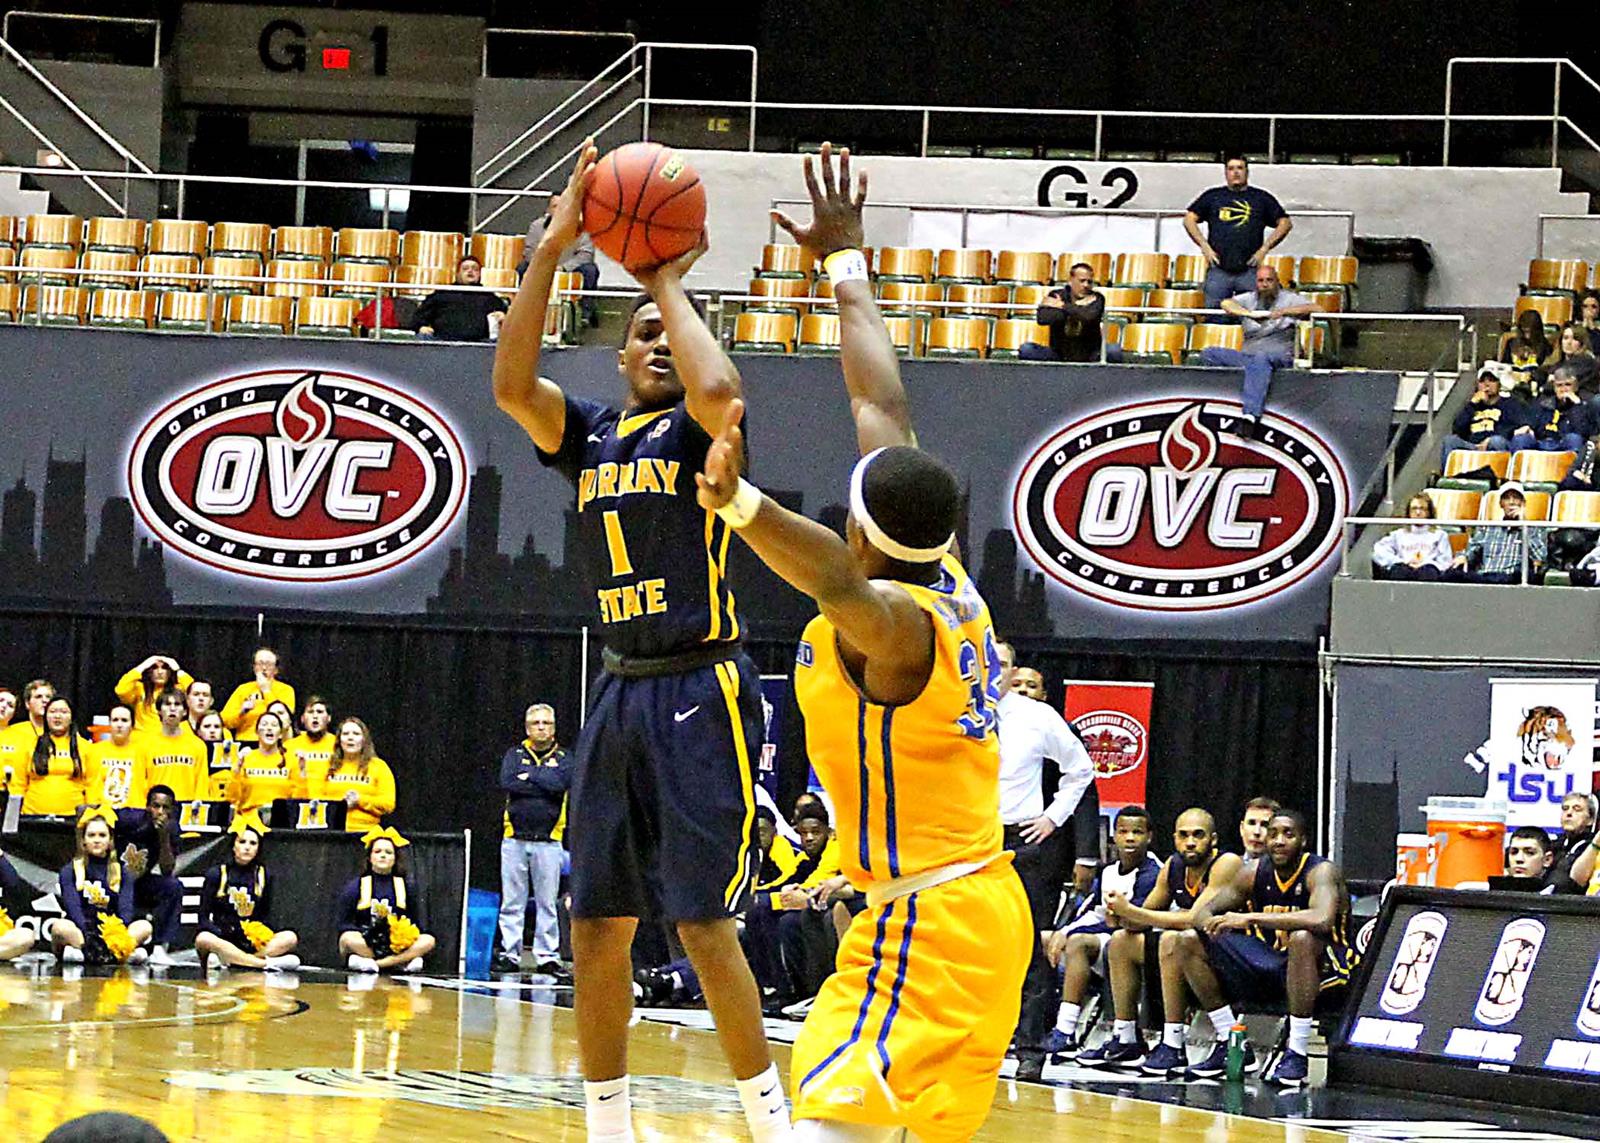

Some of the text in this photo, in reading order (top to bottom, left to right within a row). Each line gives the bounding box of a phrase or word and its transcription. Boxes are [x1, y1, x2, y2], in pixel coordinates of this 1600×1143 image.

[168, 389, 448, 461] OHIO VALLEY
[1054, 418, 1331, 485] OHIO VLLEY
[195, 436, 393, 522] OVC
[1079, 466, 1277, 549] OVC
[173, 519, 412, 566] CONFERENCE
[602, 510, 634, 577] 1
[1057, 551, 1295, 595] CONFERENCE
